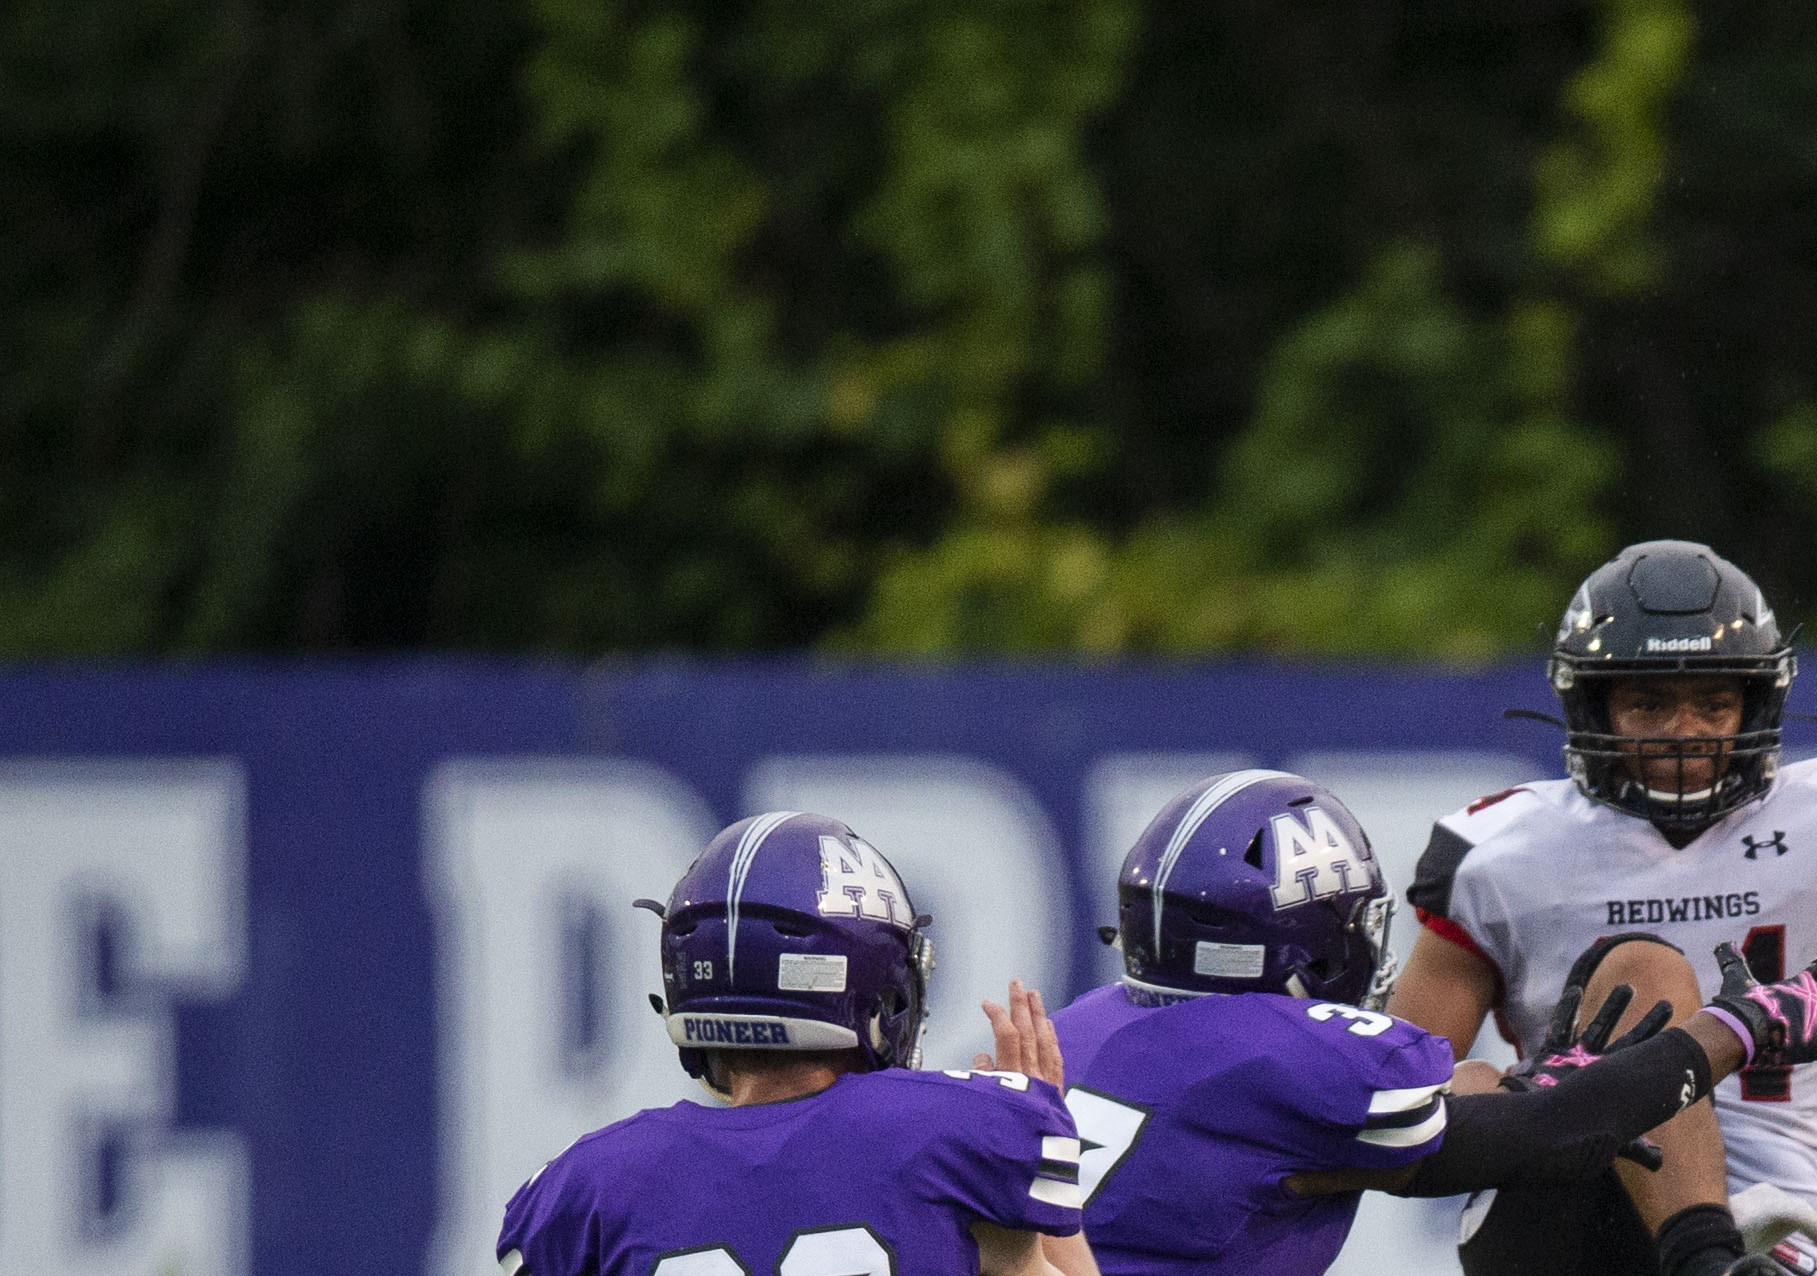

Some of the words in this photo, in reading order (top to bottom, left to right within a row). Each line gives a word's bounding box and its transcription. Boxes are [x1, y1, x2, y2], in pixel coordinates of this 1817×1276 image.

[1646, 637, 1712, 652] Riddell
[1606, 892, 1760, 925] REDWINGS
[693, 960, 713, 980] 33
[683, 1018, 790, 1045] PIONEER
[1063, 1084, 1152, 1210] 7
